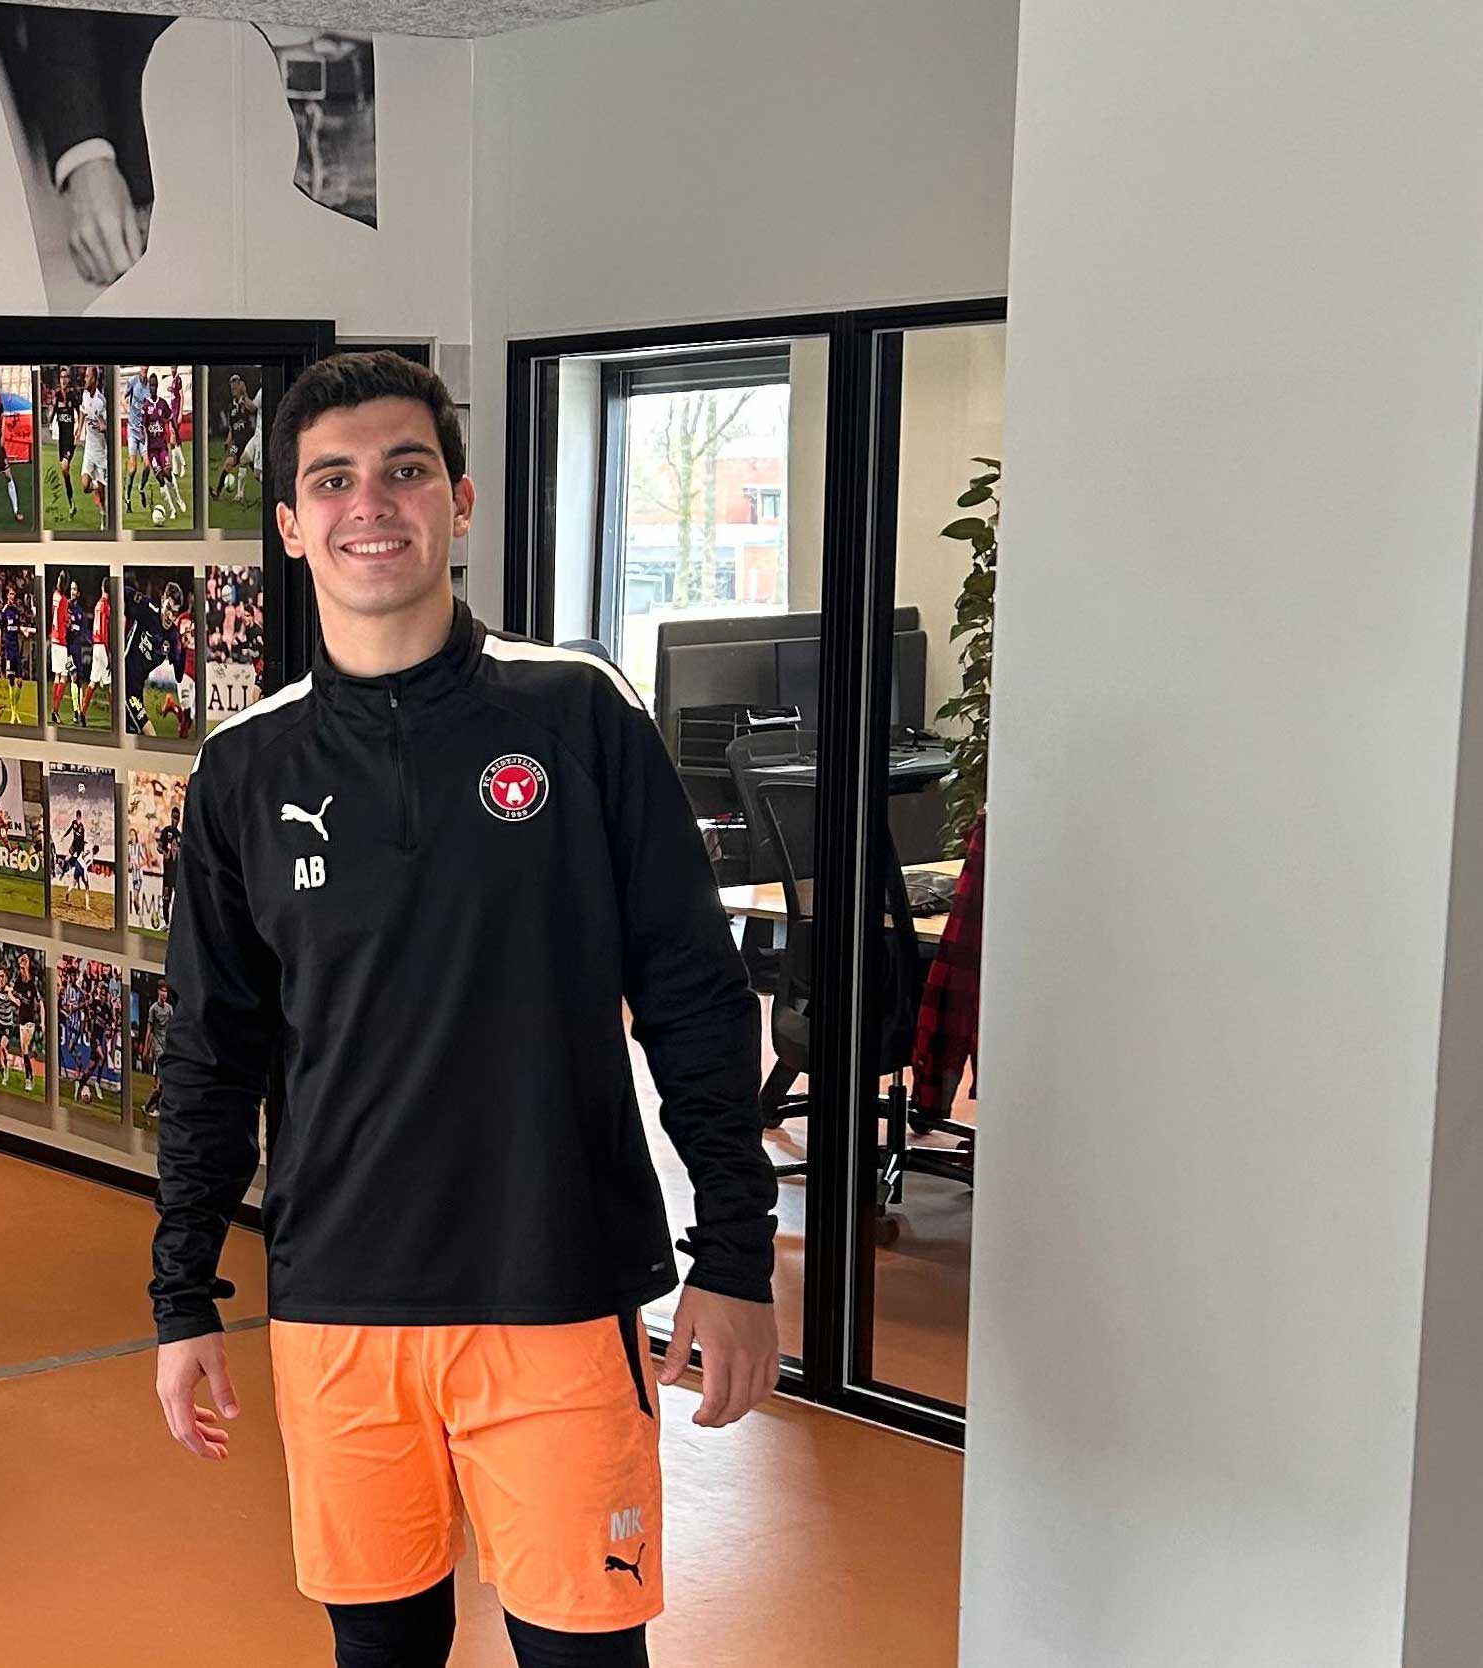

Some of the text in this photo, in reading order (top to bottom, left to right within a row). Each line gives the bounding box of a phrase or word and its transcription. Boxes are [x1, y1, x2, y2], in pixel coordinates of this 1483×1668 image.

[505, 809, 528, 818] 1999
[294, 855, 326, 891] AB
[610, 1504, 645, 1543] MK
